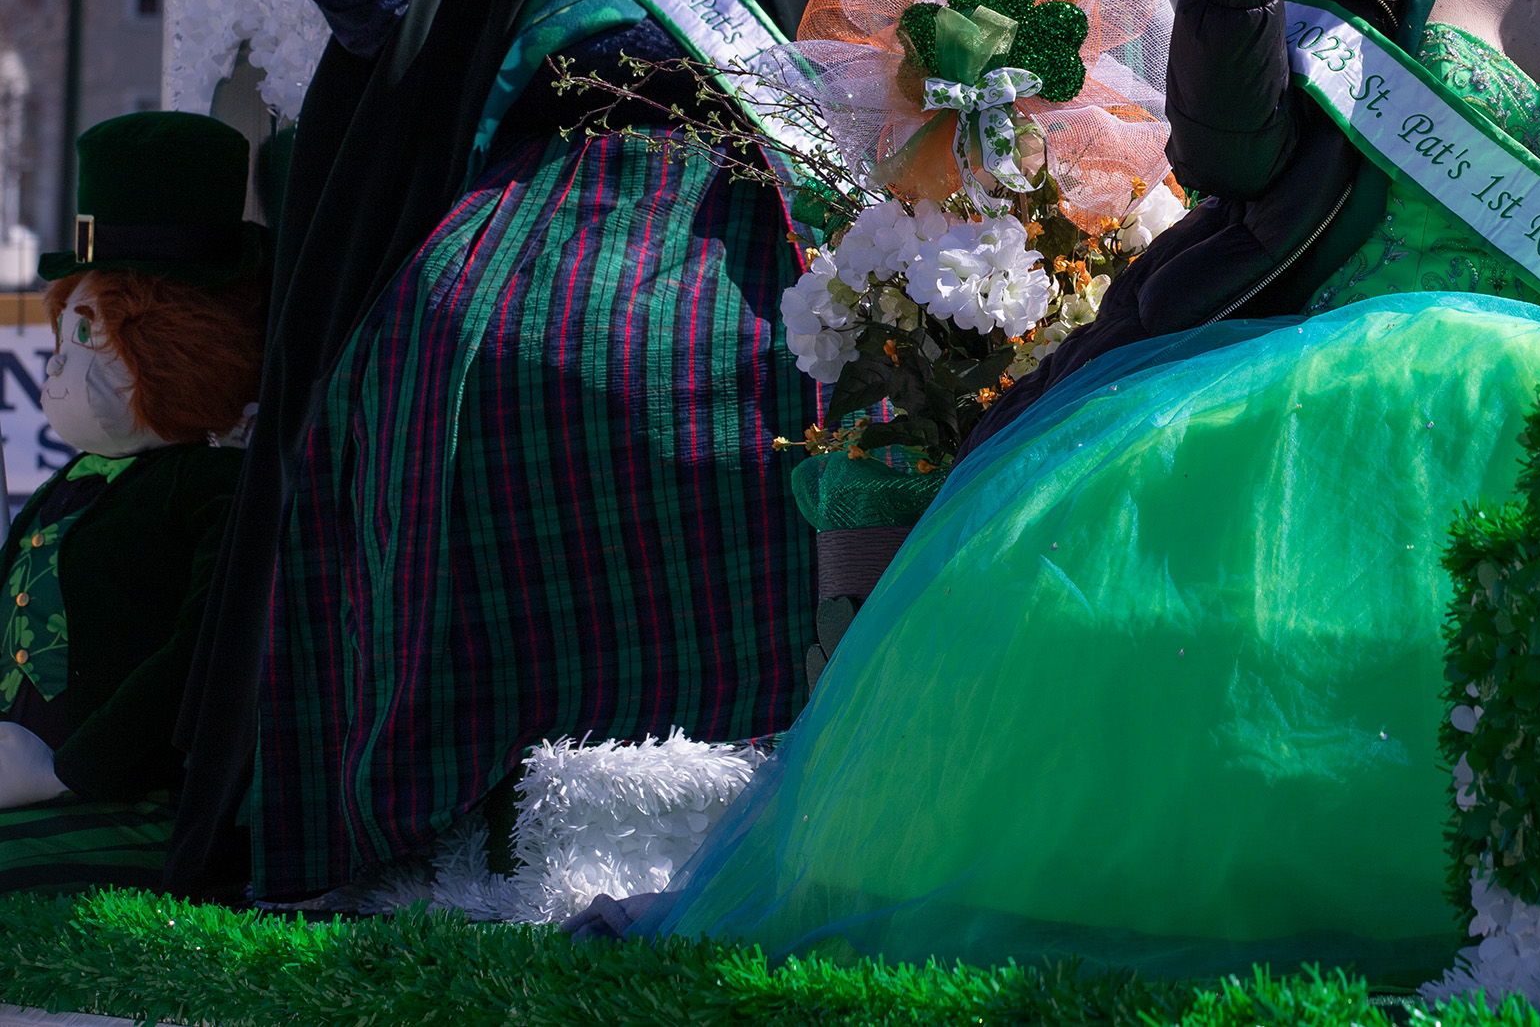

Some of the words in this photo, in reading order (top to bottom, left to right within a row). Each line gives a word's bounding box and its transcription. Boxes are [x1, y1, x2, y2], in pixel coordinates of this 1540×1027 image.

[1286, 20, 1356, 72] 2023
[1349, 74, 1392, 119] St.
[1396, 113, 1472, 181] Pat's
[1471, 174, 1525, 221] 1st
